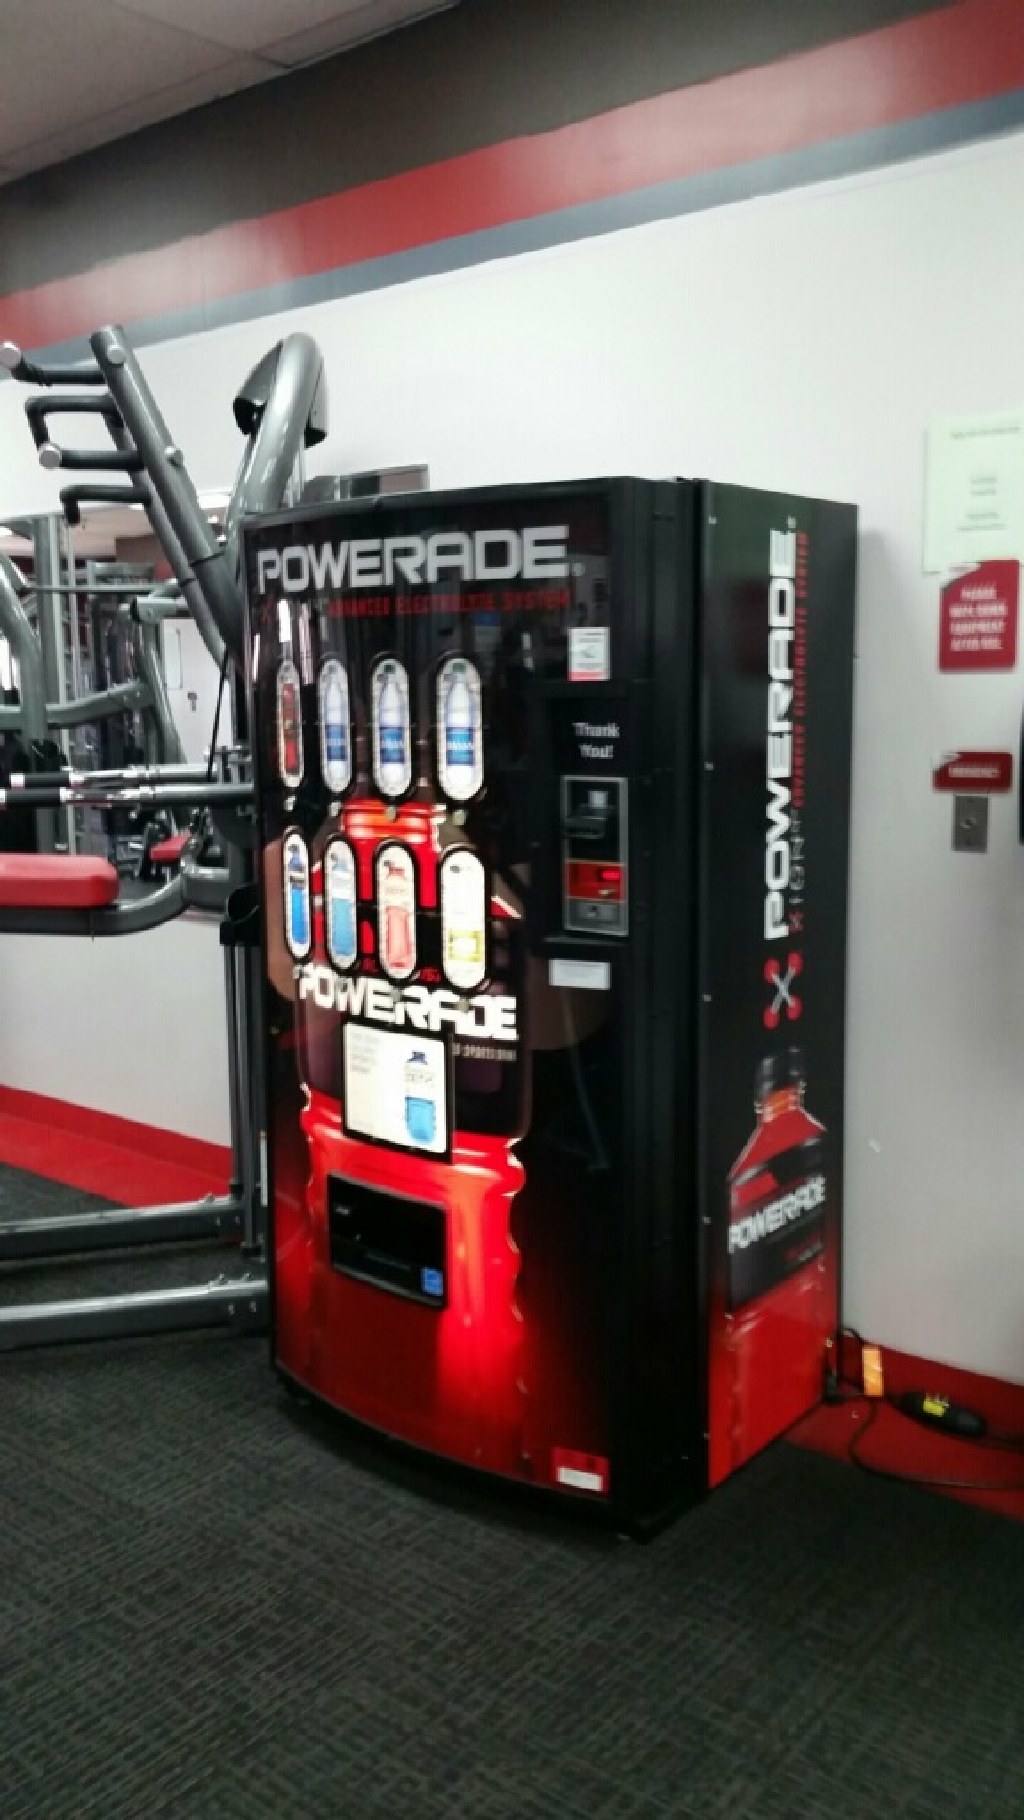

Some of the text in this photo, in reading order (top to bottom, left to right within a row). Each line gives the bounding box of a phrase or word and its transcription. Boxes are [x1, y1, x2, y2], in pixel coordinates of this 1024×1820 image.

[257, 525, 569, 595] POWERADE
[572, 722, 620, 738] Thank
[579, 743, 614, 759] You!
[764, 529, 797, 940] POWERADE
[298, 962, 519, 1041] POWERADE
[728, 1173, 826, 1254] POWERADE
